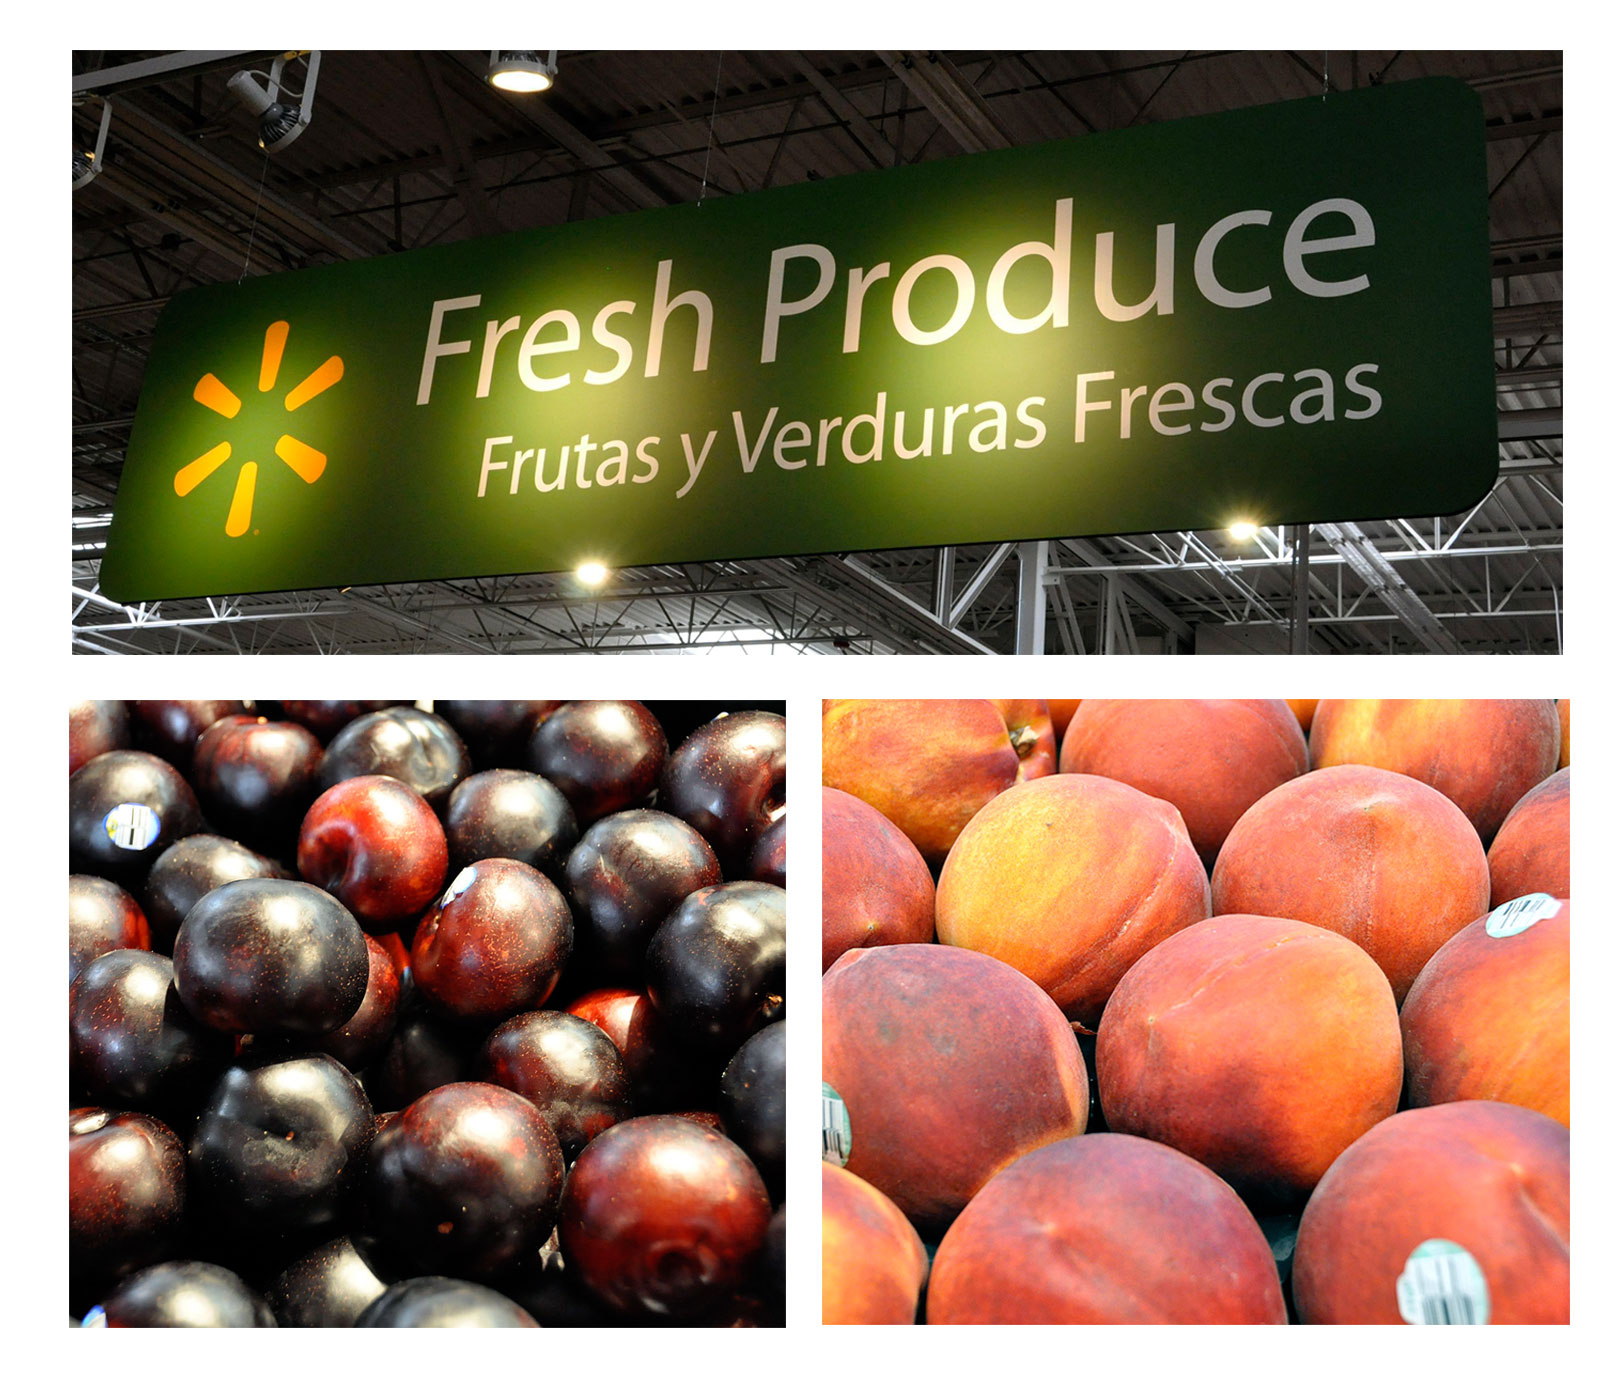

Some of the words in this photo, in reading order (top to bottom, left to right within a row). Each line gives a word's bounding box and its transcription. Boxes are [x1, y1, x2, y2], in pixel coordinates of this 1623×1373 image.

[416, 259, 714, 406] Fresh
[760, 197, 1376, 363] Produce
[477, 433, 660, 497] Frutas
[675, 430, 718, 499] y
[732, 391, 1047, 473] Verduras
[1074, 362, 1383, 443] Frescas
